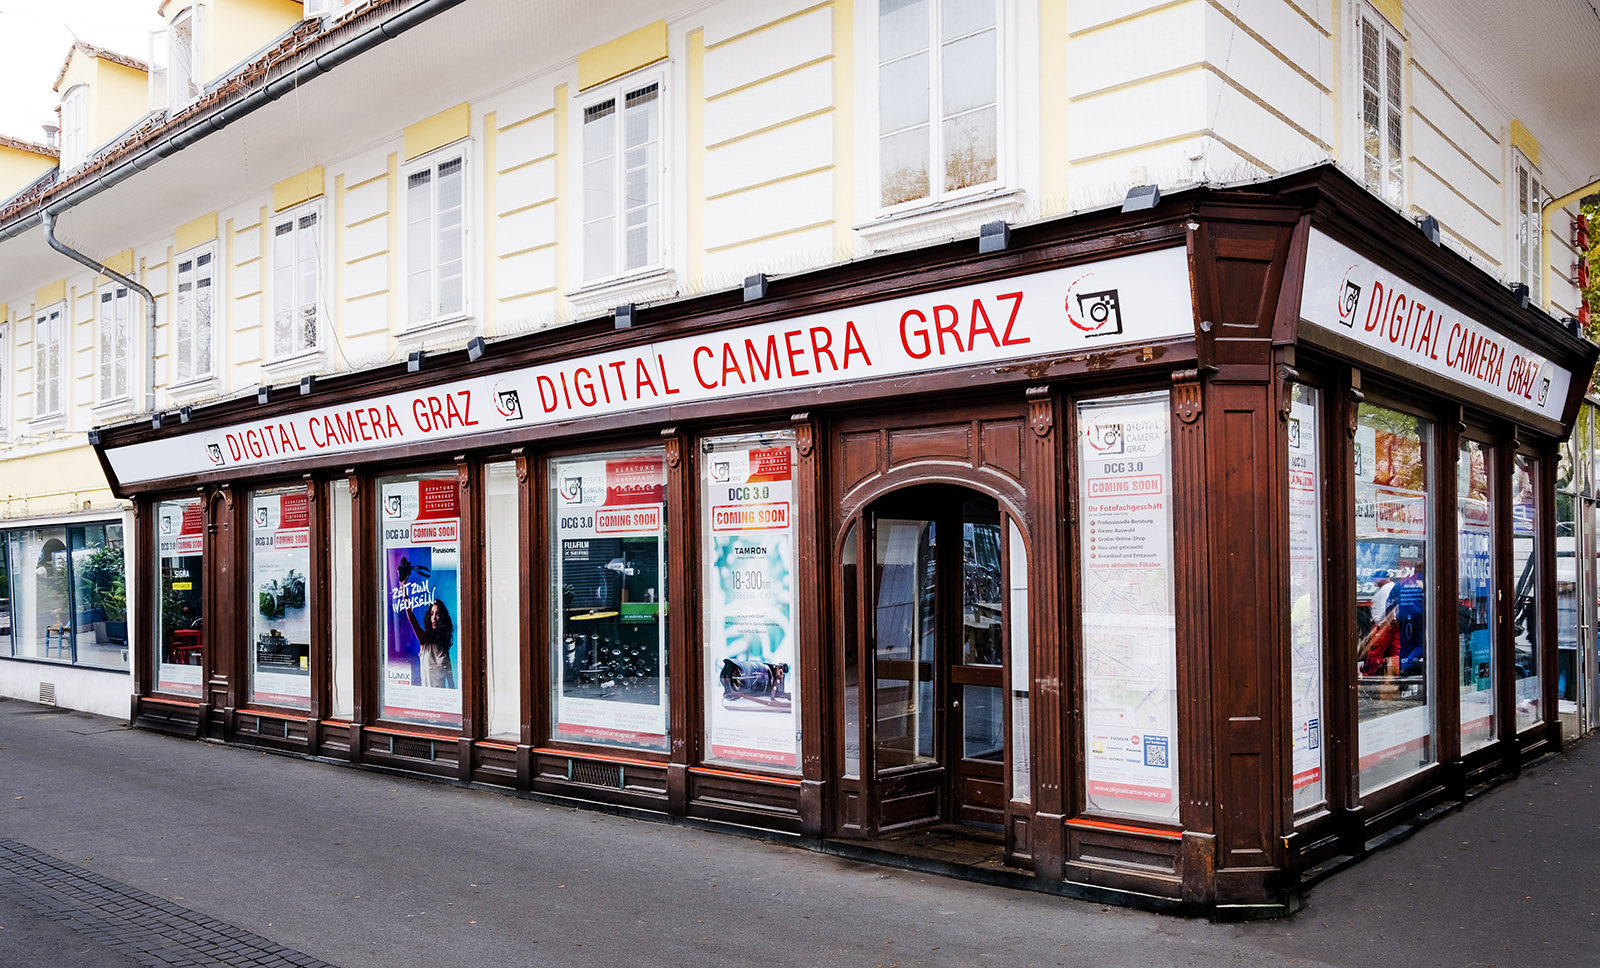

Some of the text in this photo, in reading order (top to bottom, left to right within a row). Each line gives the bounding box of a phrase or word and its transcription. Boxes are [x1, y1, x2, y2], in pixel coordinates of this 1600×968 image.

[1364, 280, 1540, 400] DIGITAL CAMERA GRAZ
[536, 291, 1030, 414] DIGITAL CAMERA GRAZ
[226, 390, 479, 462] DIGITAL CAMERA GRAZ
[1126, 422, 1160, 432] DIGITAL
[1126, 432, 1160, 442] CAMERA
[1126, 444, 1146, 453] GRAZ
[1104, 462, 1143, 474] DCG 3.0
[1092, 480, 1158, 493] COMING SOON
[728, 486, 769, 500] DCG 3.0
[1100, 503, 1162, 512] Fotofachgeschäft
[562, 517, 593, 529] DCG 3.0
[599, 513, 656, 528] COMING SOON
[716, 510, 785, 524] COMING SOON
[386, 529, 409, 539] DCG 3.0
[414, 527, 455, 538] COMING SOON
[276, 535, 308, 544] COMING SOON
[392, 582, 411, 599] ZEIT
[722, 749, 784, 761] www.digitalcameragraz.at
[1094, 785, 1166, 798] www.digitalcameragraz.at
